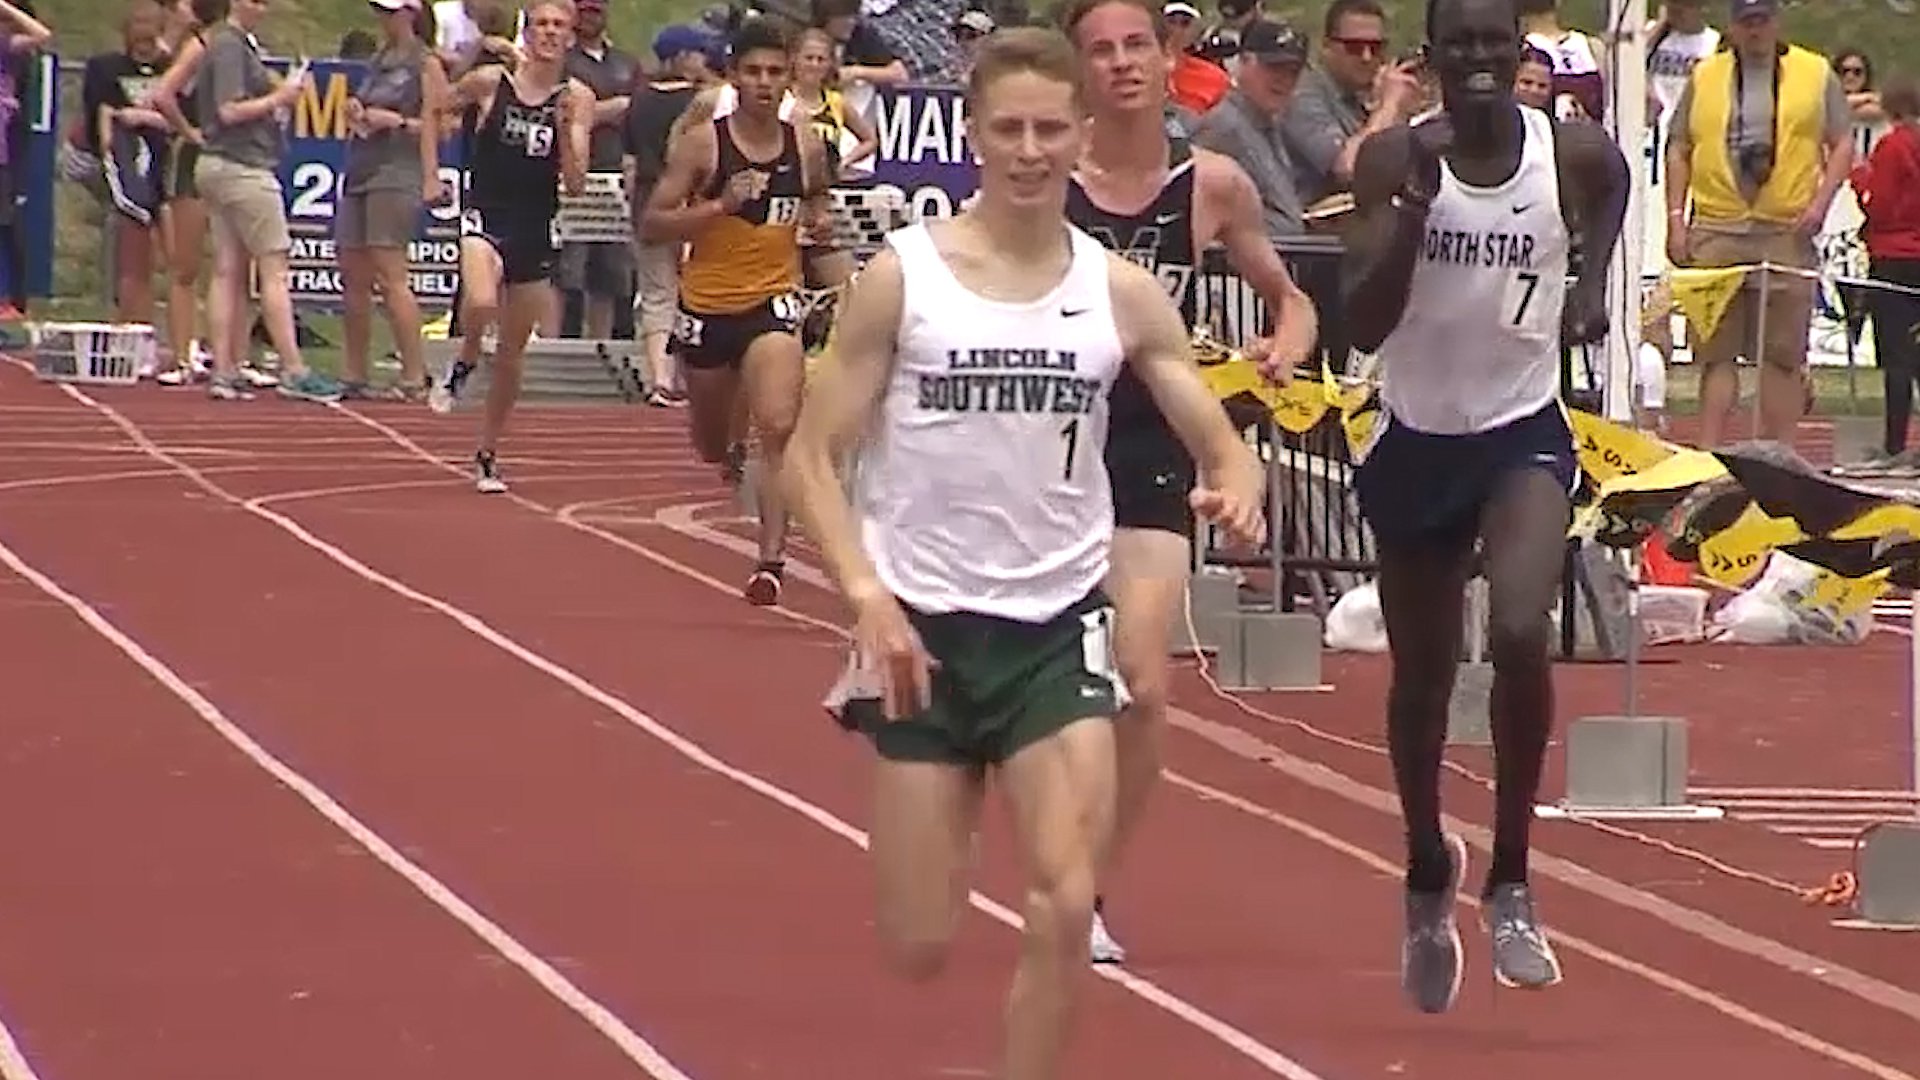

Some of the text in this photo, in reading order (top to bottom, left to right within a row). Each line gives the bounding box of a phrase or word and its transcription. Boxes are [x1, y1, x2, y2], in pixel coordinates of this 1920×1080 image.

[1420, 229, 1535, 269] ORTH STAR
[1513, 272, 1539, 326] 7
[947, 349, 1076, 371] LINCOLN
[918, 374, 1102, 414] SOUTHWEST
[1060, 419, 1078, 481] 1
